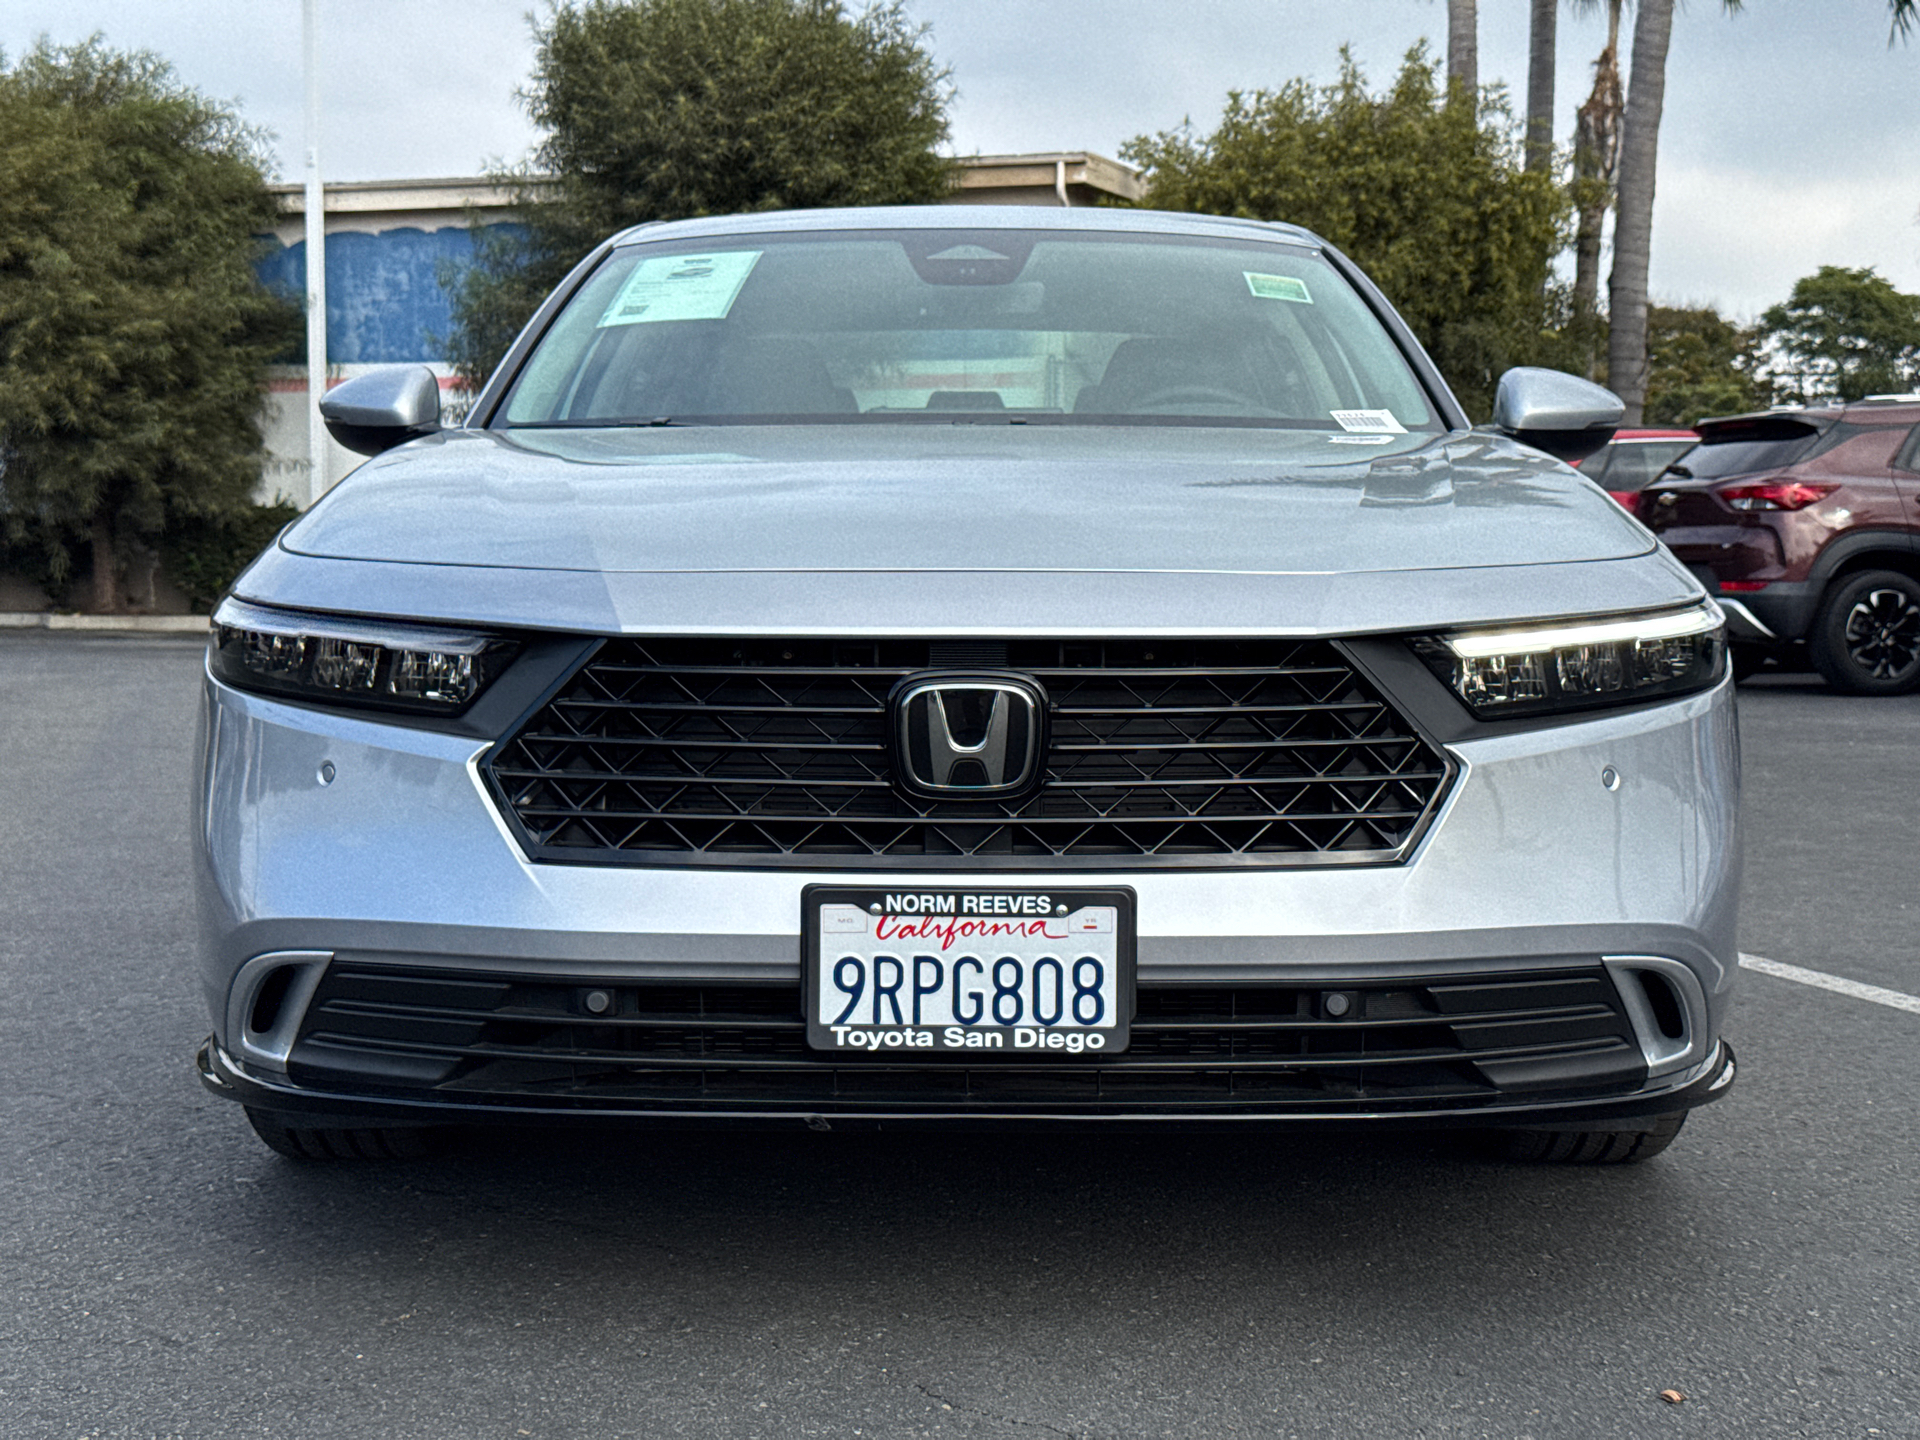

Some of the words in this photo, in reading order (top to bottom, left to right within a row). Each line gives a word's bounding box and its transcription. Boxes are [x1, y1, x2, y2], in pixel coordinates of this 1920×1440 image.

[886, 894, 956, 914] NORM
[962, 895, 1052, 915] REEVES
[876, 915, 1069, 951] California
[833, 956, 1105, 1026] 9RPG808
[830, 1026, 934, 1051] Toyota
[943, 1027, 1004, 1048] San
[1014, 1028, 1105, 1053] Diego
